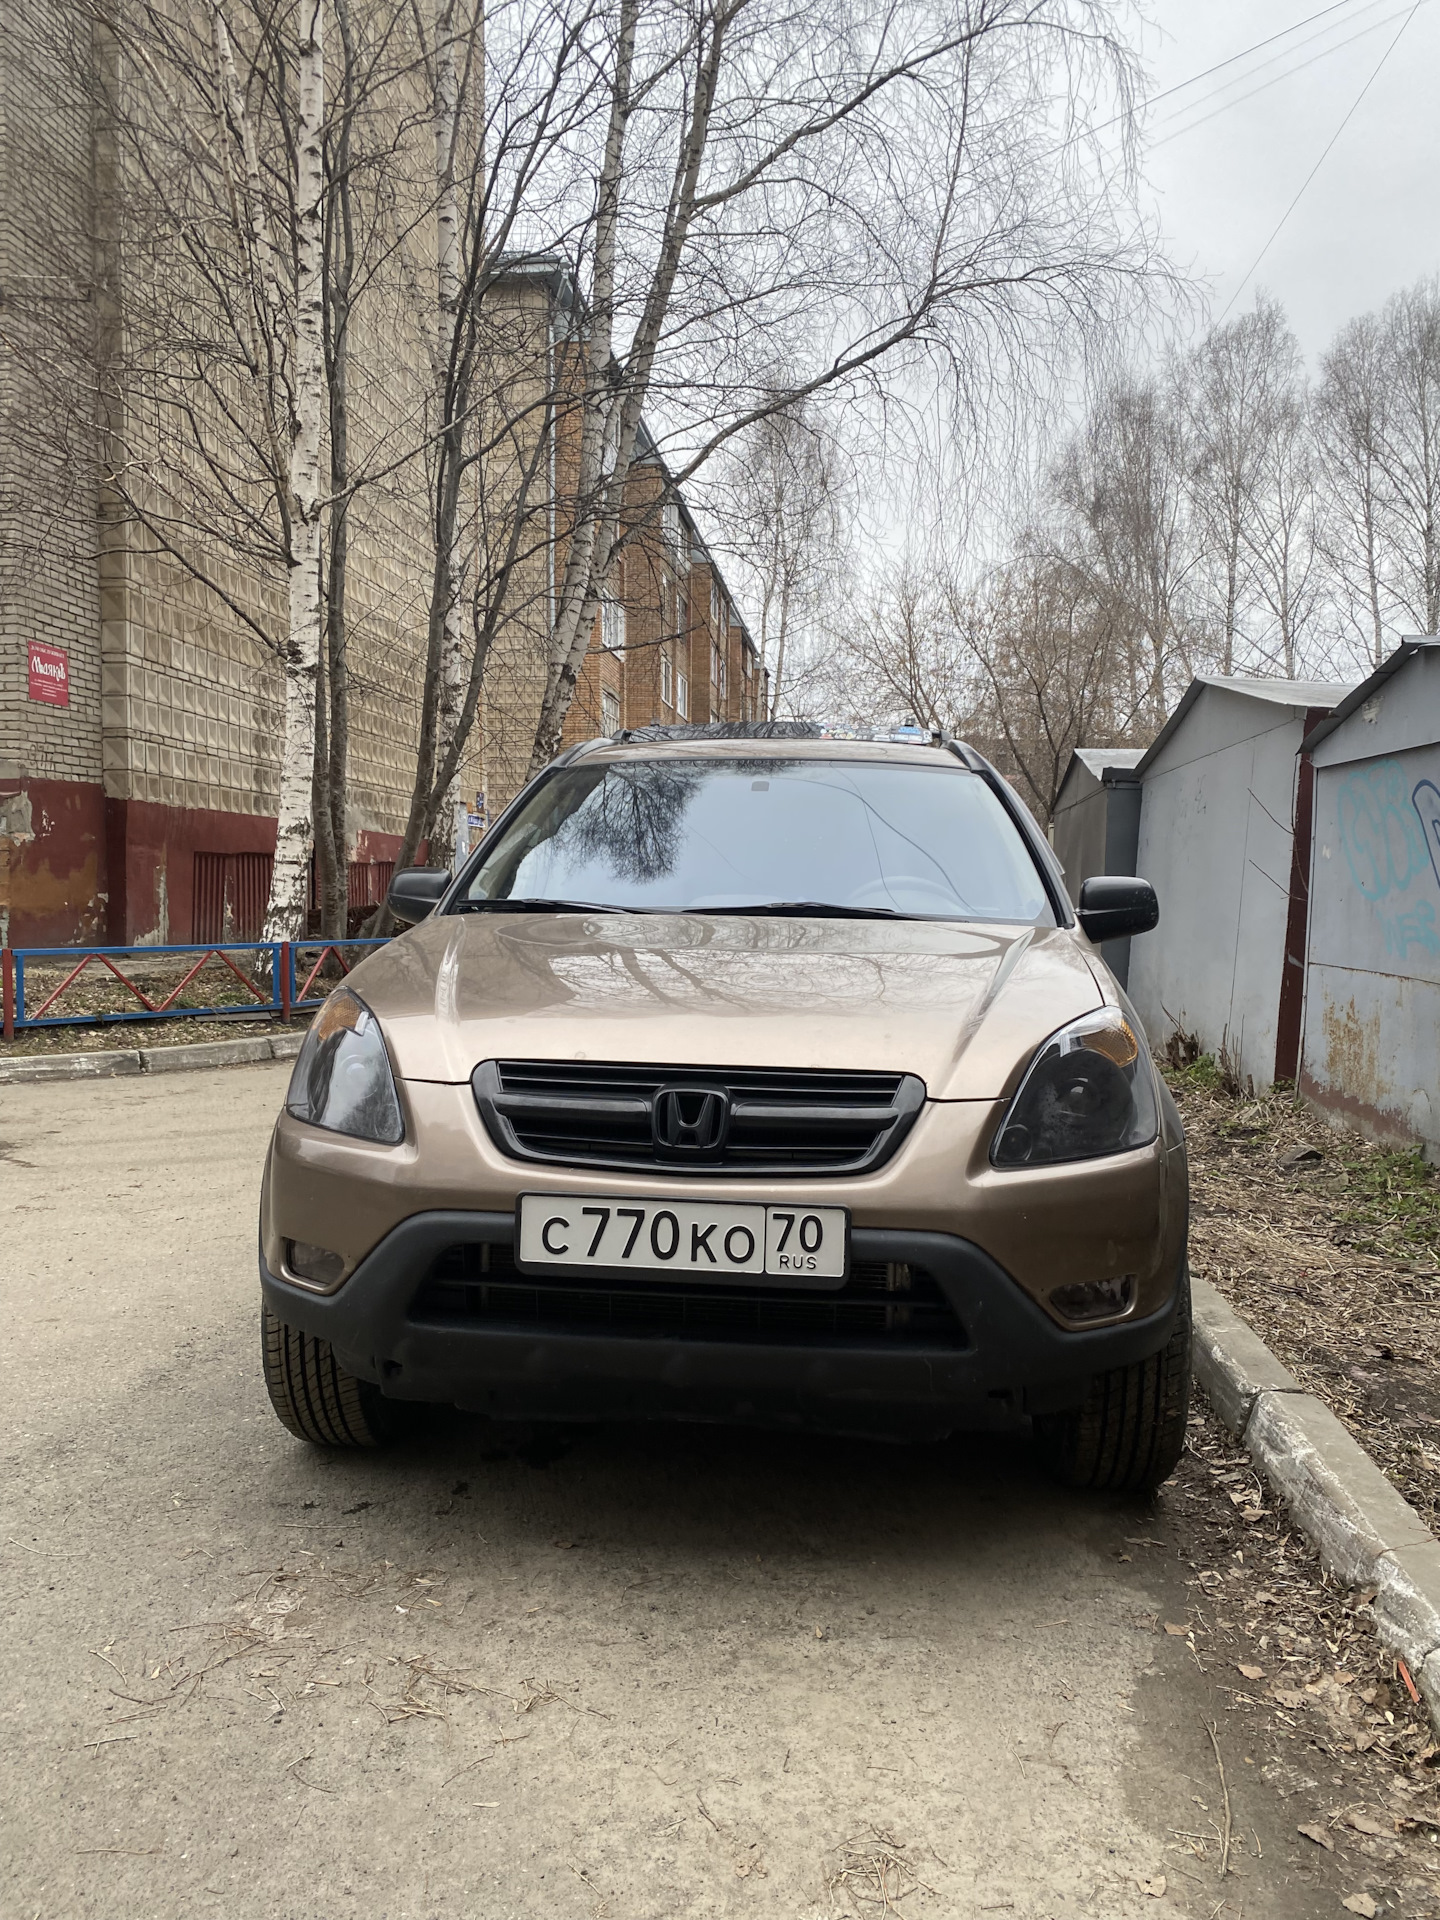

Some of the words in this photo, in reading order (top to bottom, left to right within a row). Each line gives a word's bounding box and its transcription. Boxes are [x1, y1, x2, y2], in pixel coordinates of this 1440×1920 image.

[541, 1206, 755, 1264] С770КО
[772, 1212, 824, 1253] 70
[778, 1253, 817, 1270] RUS
